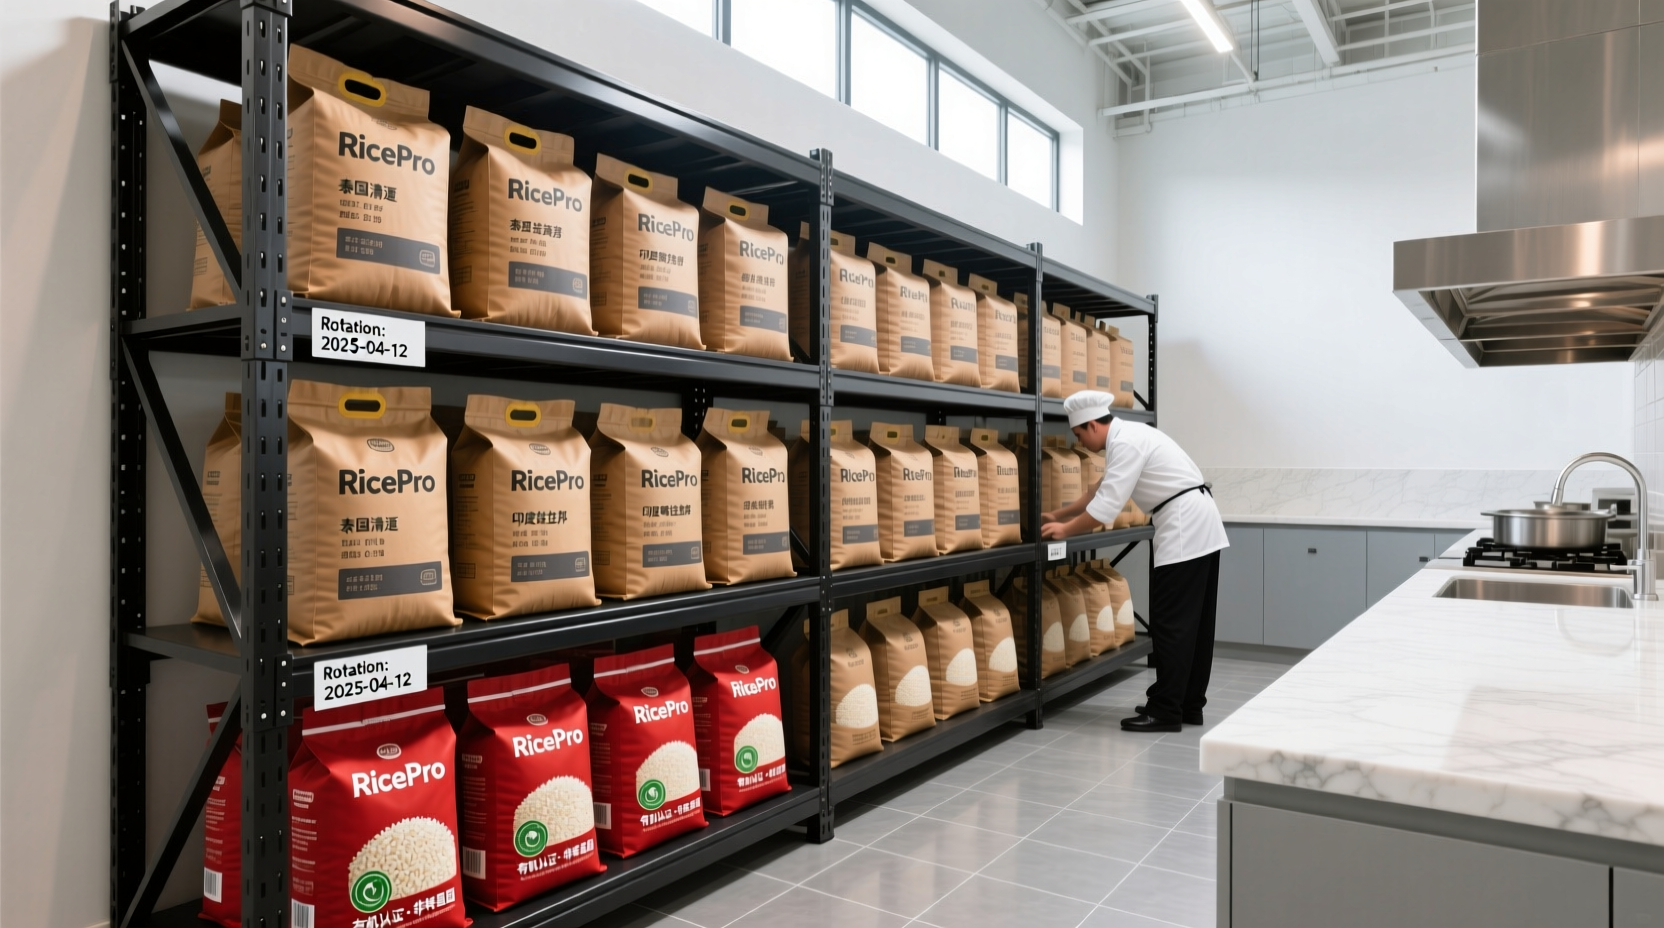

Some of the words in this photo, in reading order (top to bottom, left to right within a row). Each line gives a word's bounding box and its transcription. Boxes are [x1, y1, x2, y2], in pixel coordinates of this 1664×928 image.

[338, 131, 435, 176] RicePro
[508, 177, 583, 212] RicePro
[638, 213, 694, 242] RicePro
[321, 316, 386, 337] Rotation:
[321, 336, 408, 358] 2025-04-12
[339, 468, 435, 495] RicePro
[511, 469, 584, 491] RicePro
[641, 469, 698, 488] RicePro
[323, 660, 389, 681] Rotation:
[324, 672, 412, 701] 2025-04-12
[731, 677, 777, 698] RicePro
[633, 700, 689, 724] RicePro
[512, 728, 583, 758] RicePro
[351, 761, 446, 798] RicePro
